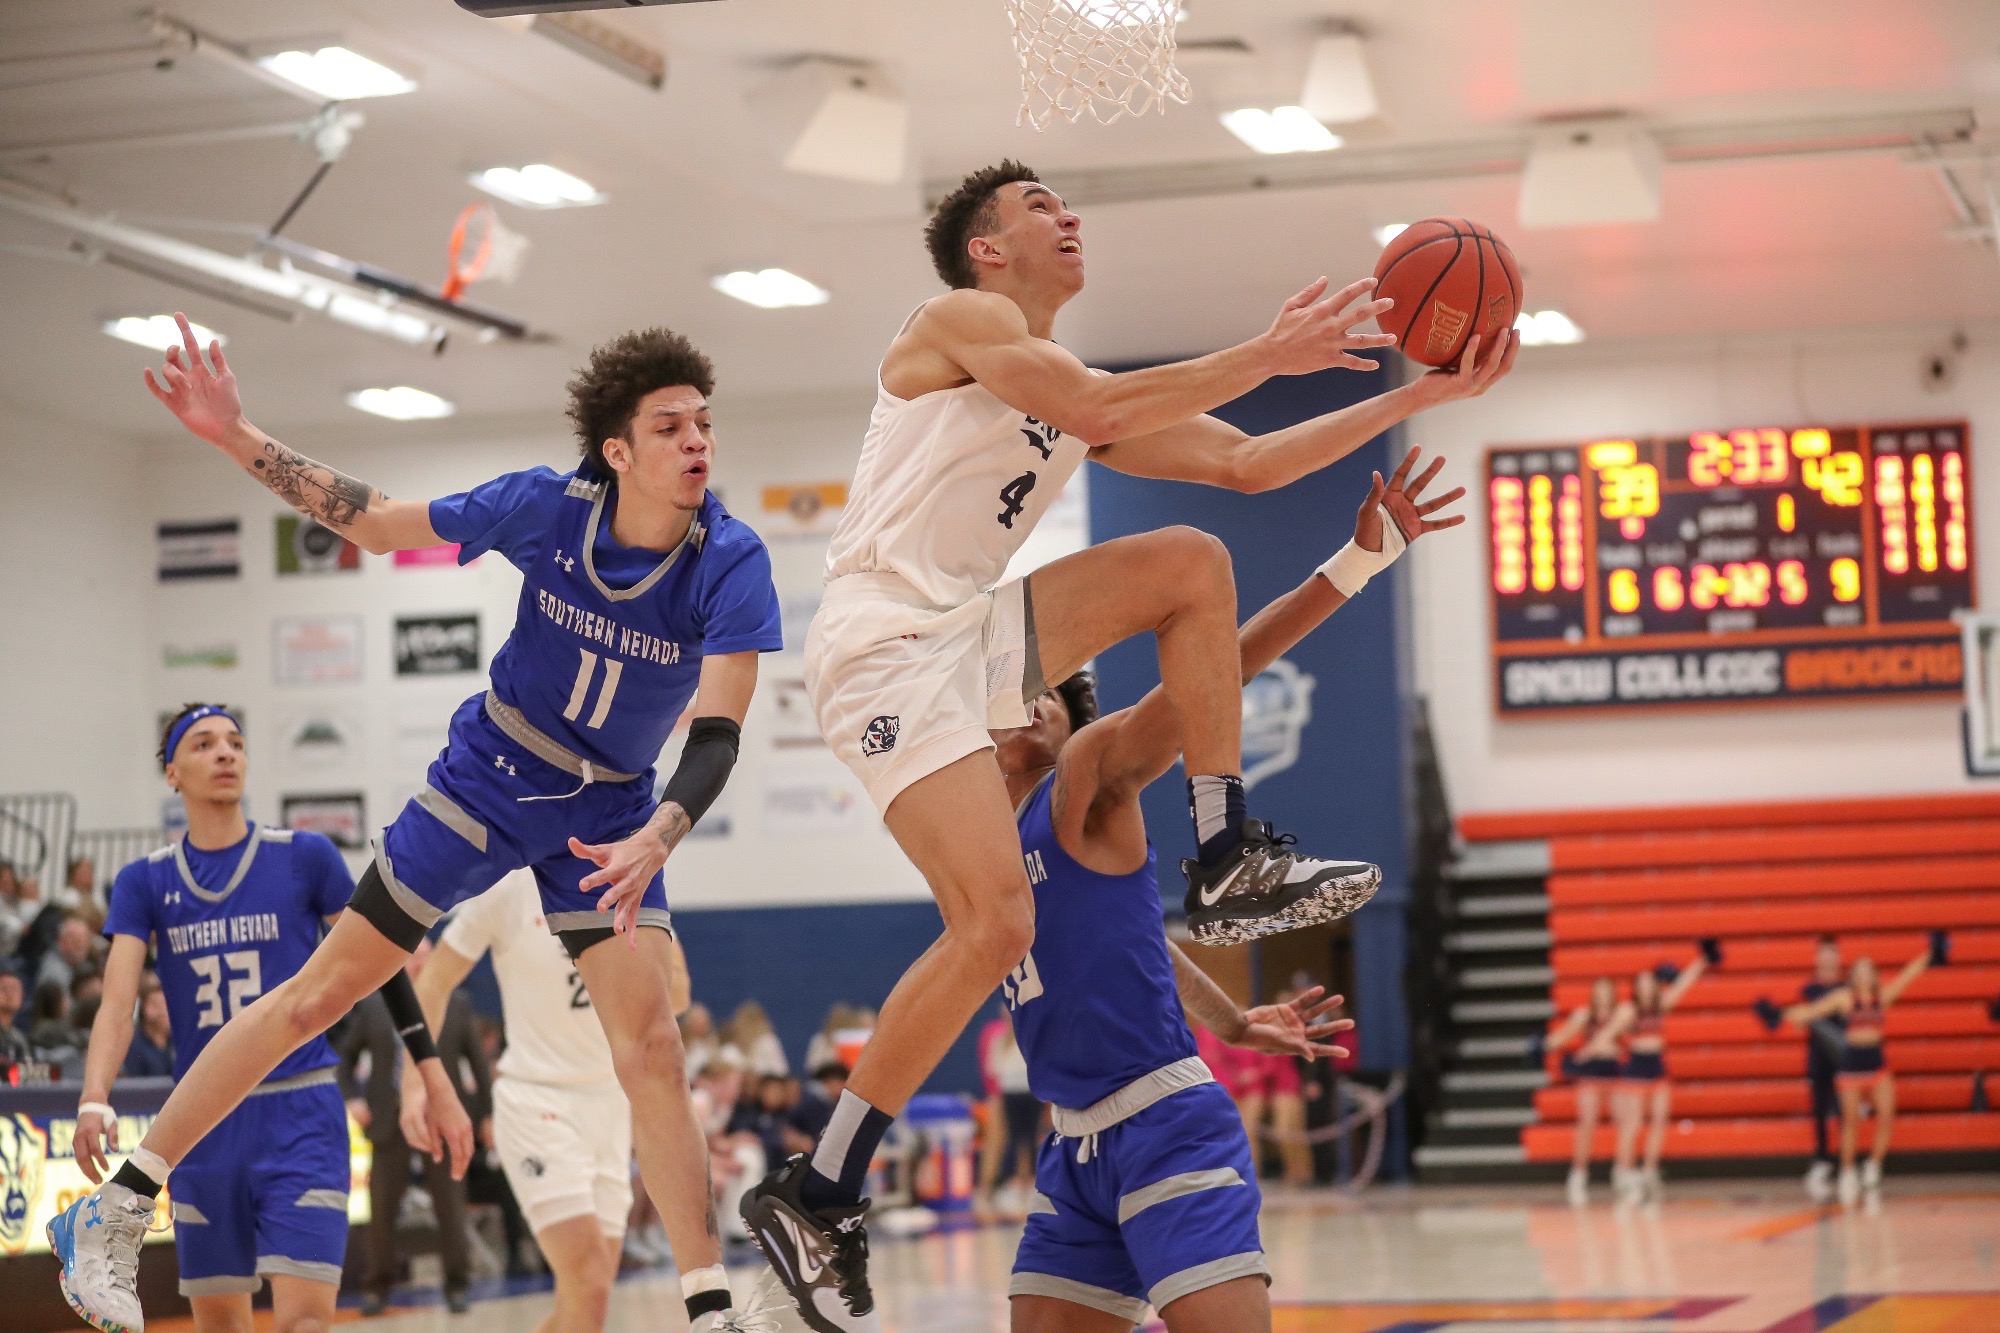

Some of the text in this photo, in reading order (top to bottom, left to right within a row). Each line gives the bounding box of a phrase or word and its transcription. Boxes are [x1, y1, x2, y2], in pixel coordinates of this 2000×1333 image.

[1688, 428, 1790, 486] 2:33
[998, 471, 1036, 529] 4
[539, 588, 680, 665] SOUTHERN NEVADA
[562, 647, 624, 730] 11
[167, 912, 279, 955] SOUTHERN NEVADA
[189, 949, 262, 1029] 32
